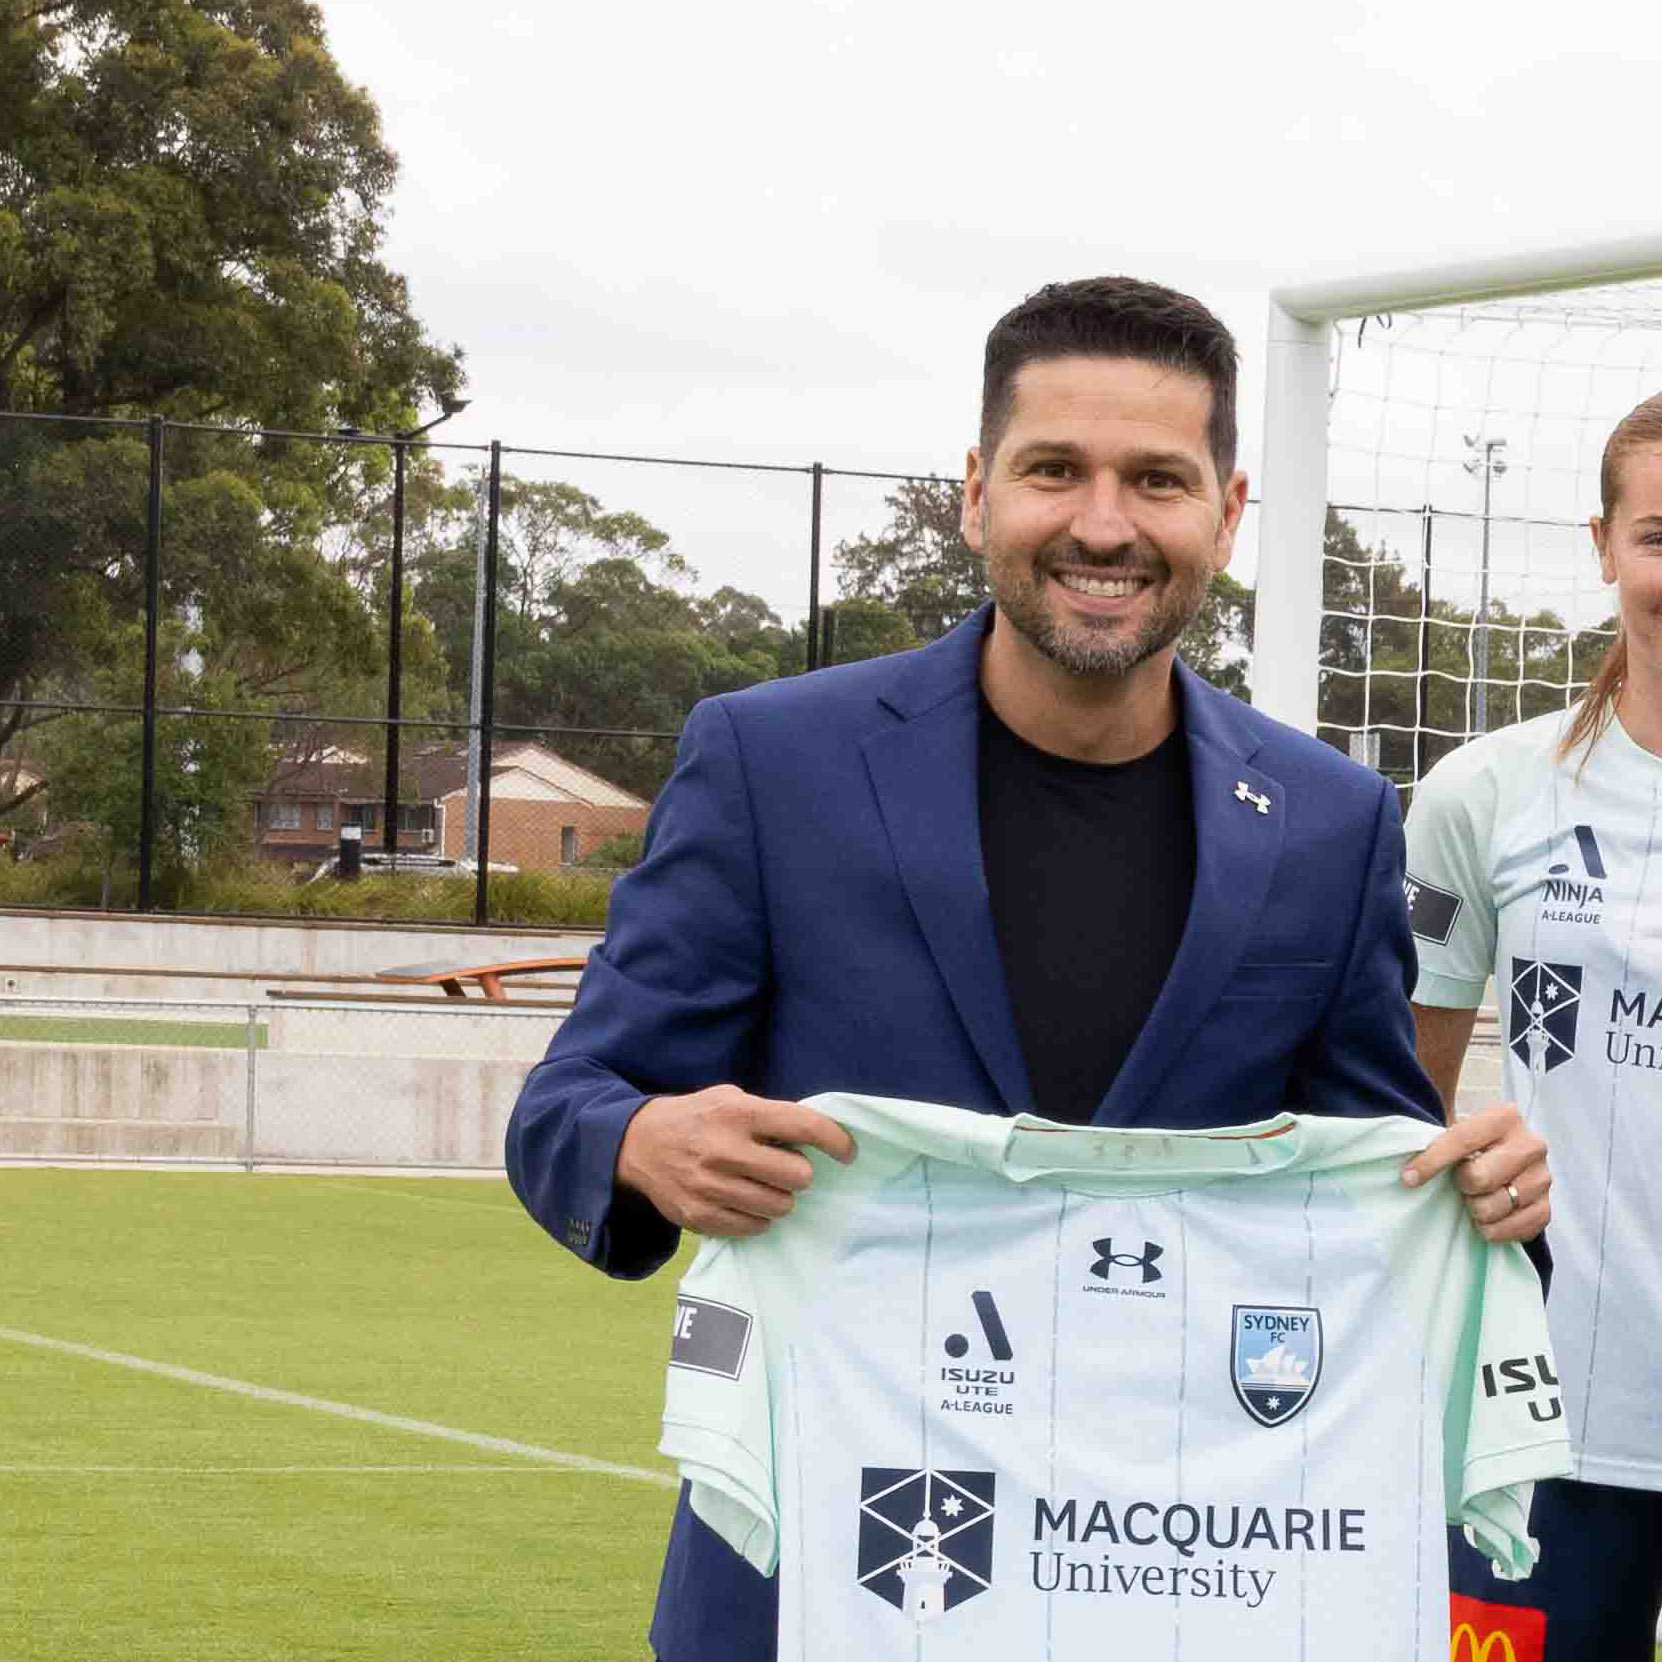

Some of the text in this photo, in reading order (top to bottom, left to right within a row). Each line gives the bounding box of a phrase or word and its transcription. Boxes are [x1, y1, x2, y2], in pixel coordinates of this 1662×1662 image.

[1543, 880, 1603, 909] NINJA
[1542, 909, 1601, 924] A-LEAGUE
[1083, 1285, 1166, 1299] UNDER ARMOUR
[1244, 1314, 1310, 1332] SYDNEY
[1270, 1331, 1286, 1343] FC
[941, 1367, 1015, 1384] ISUZU
[956, 1384, 998, 1396] UTE
[941, 1399, 1014, 1415] A-LEAGUE
[1528, 1396, 1562, 1422] U
[1033, 1497, 1366, 1557] MACQUARIE
[1029, 1551, 1277, 1608] University
